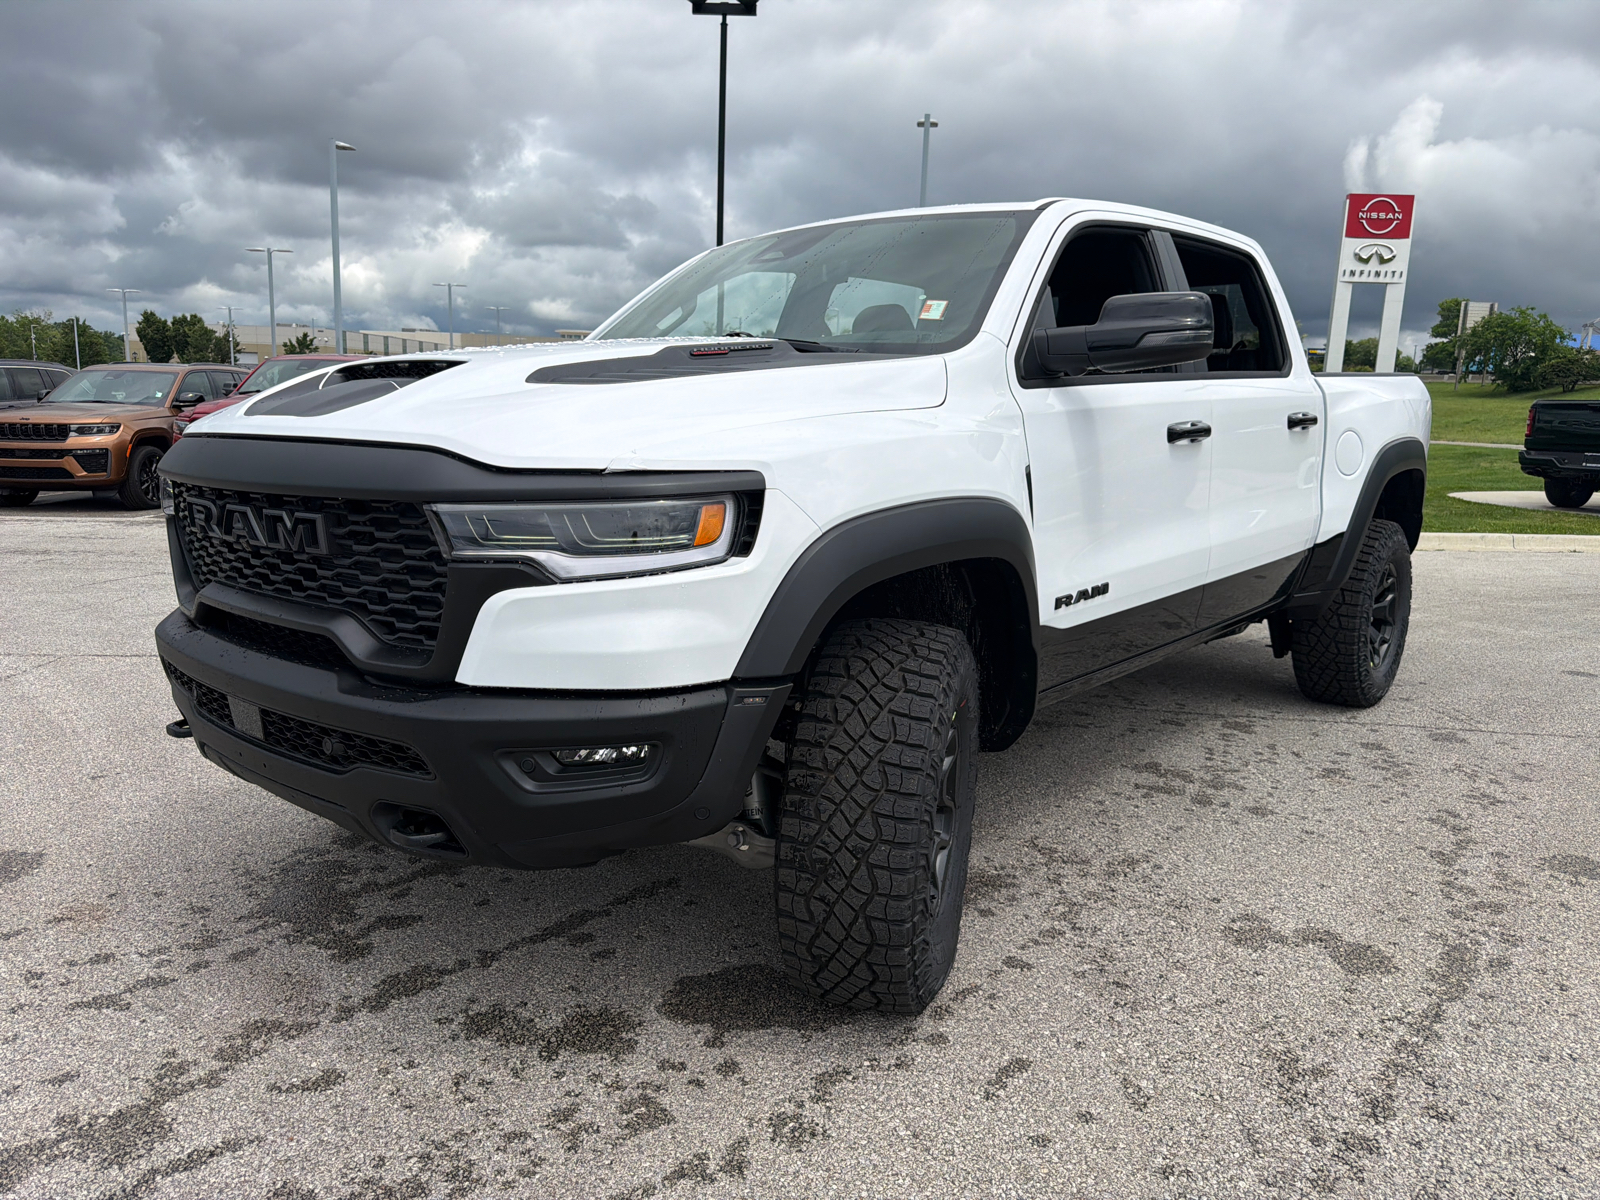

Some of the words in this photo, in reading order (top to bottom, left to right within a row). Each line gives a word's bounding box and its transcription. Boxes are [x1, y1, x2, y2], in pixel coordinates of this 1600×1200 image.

[1358, 211, 1403, 220] NISSAN
[1342, 269, 1404, 279] INFINITI
[186, 496, 329, 555] RAM
[1054, 581, 1110, 611] RAM
[742, 805, 764, 817] STEIN
